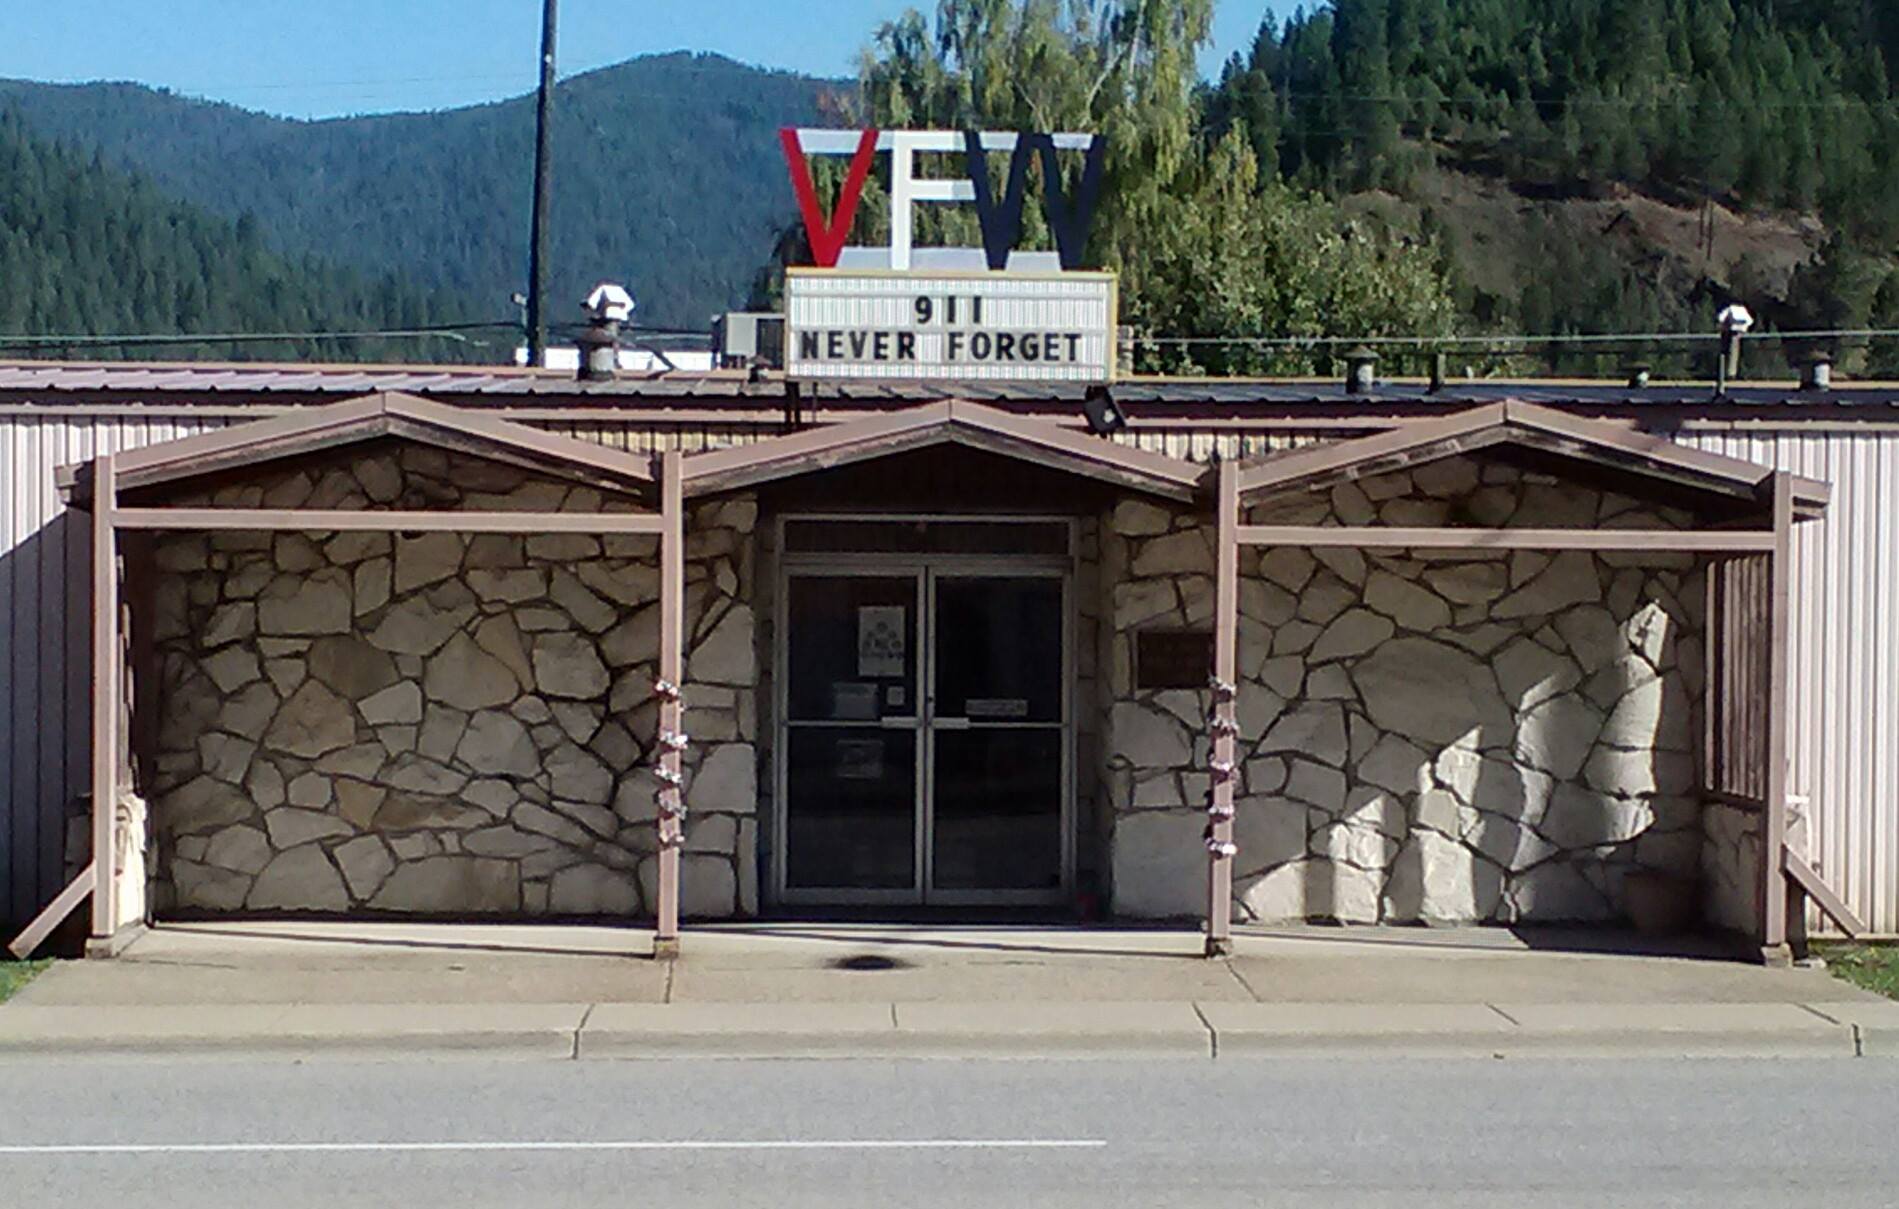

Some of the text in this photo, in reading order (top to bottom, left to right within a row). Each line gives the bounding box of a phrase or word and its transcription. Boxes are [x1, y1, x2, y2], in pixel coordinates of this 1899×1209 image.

[779, 128, 1107, 271] VFW
[914, 295, 982, 324] 911
[801, 331, 1082, 361] NEVER FORGET
